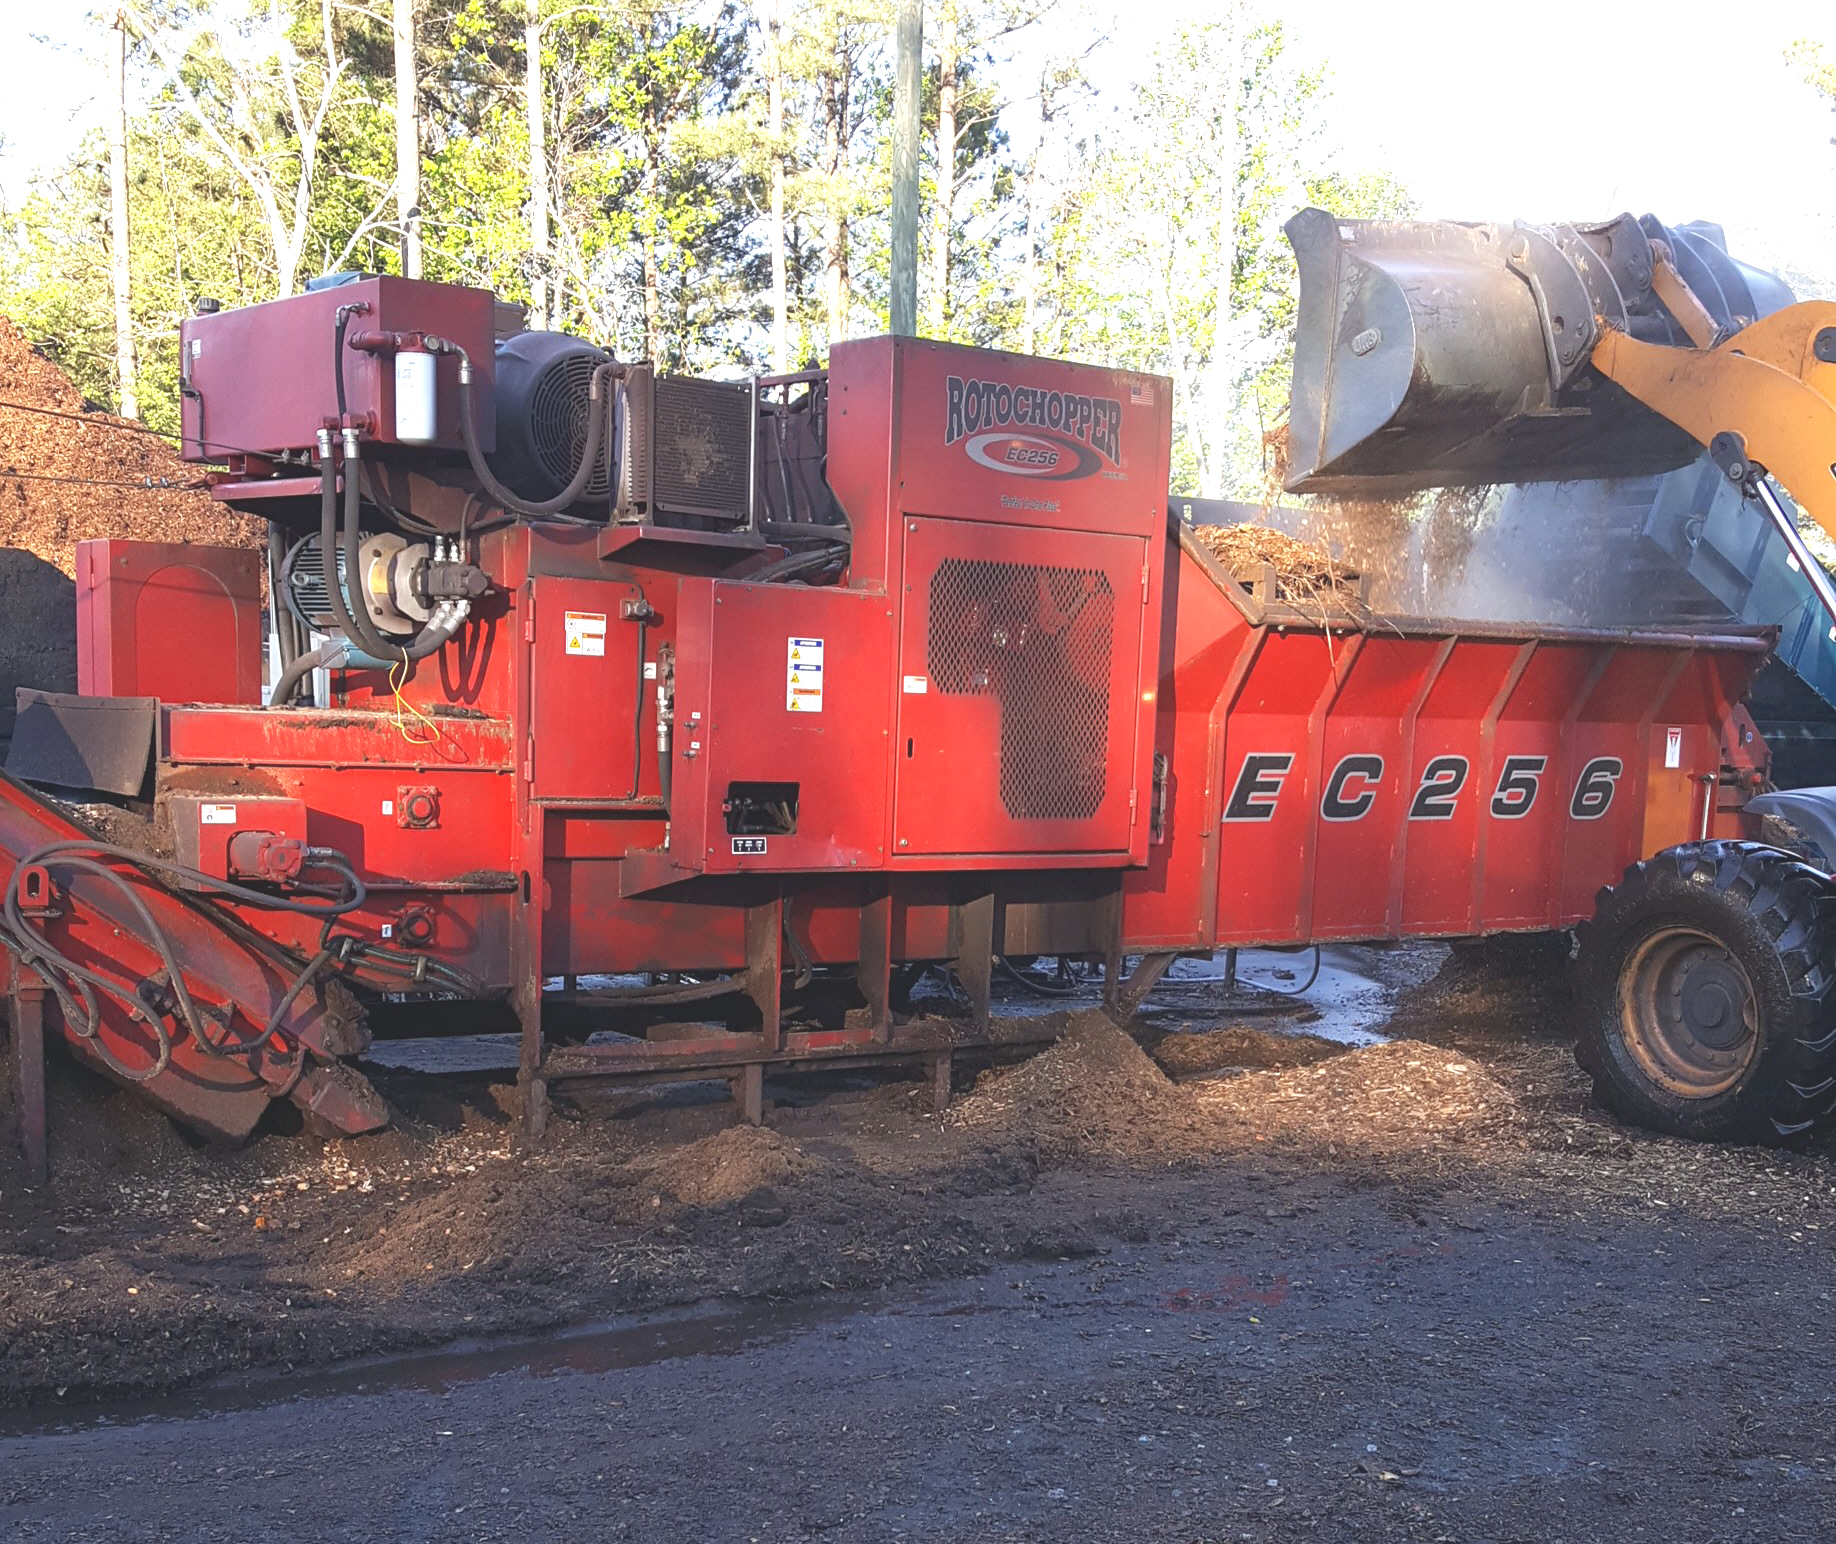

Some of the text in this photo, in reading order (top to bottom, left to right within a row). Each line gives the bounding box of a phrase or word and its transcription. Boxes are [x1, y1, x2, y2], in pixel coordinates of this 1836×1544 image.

[945, 376, 1122, 468] ROTOCHOPPER
[1005, 447, 1059, 466] EC256
[1222, 753, 1623, 821] EC256
